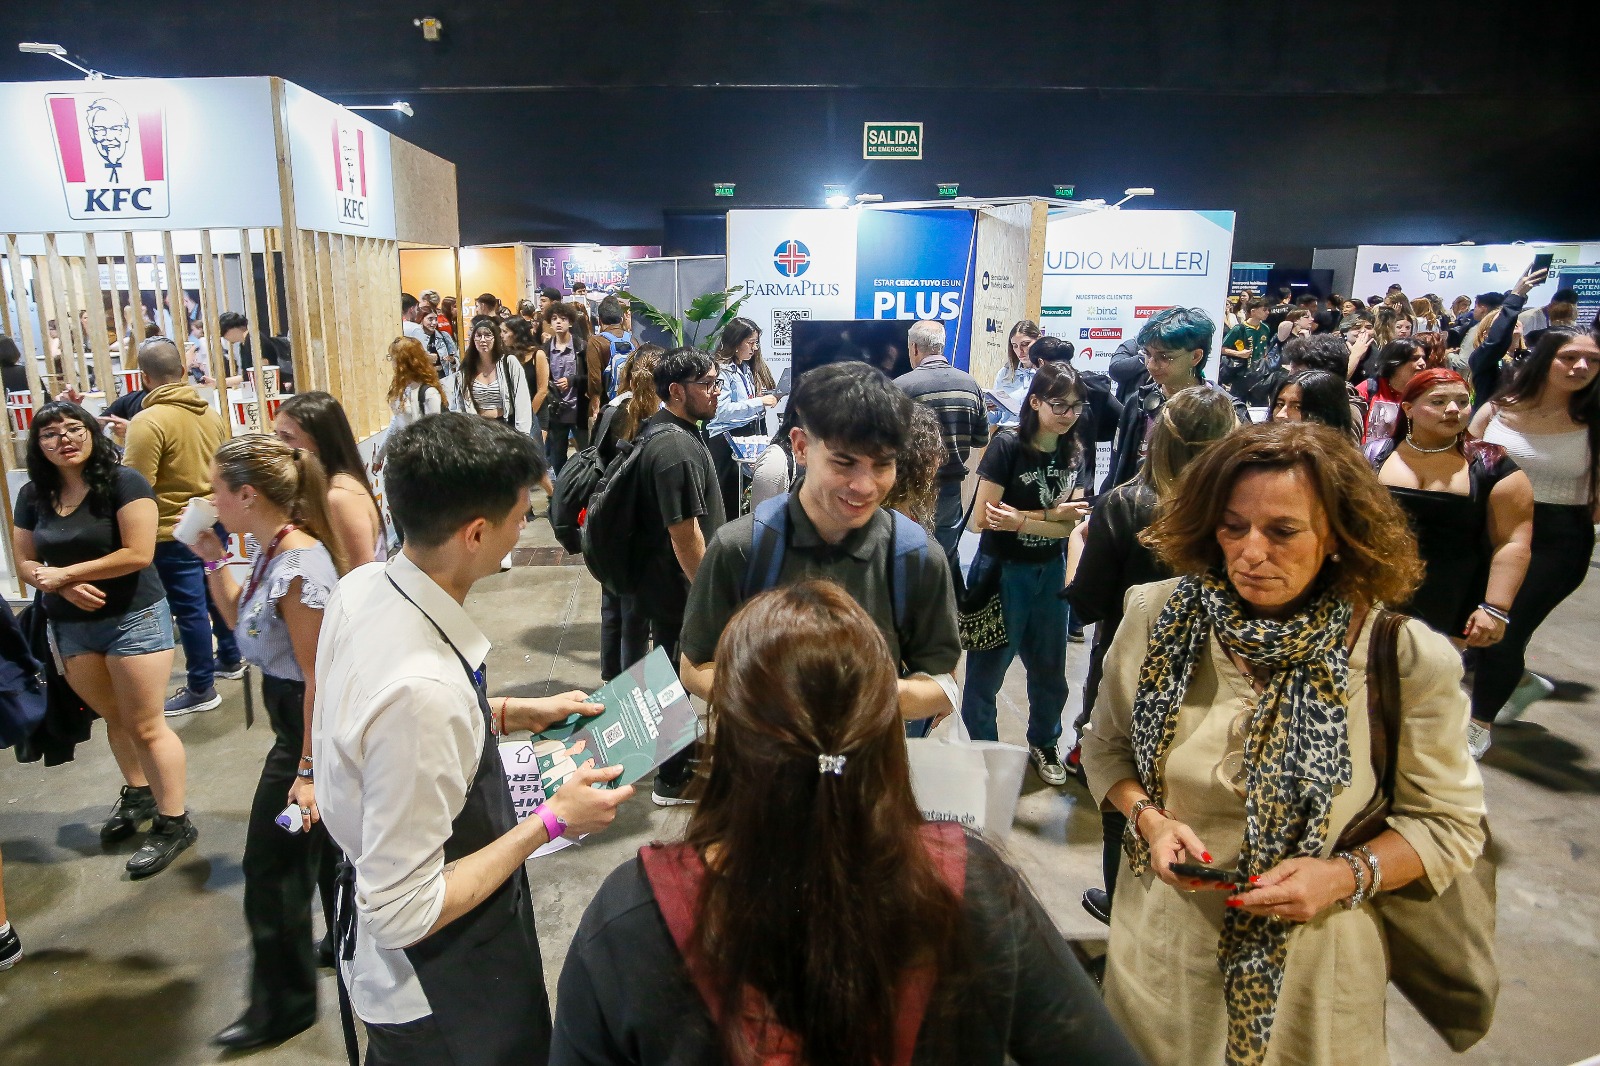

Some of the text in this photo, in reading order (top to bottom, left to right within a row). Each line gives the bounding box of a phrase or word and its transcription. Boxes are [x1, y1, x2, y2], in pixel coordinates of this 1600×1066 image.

[868, 129, 918, 145] SALIDA
[84, 187, 153, 212] KFC
[343, 197, 365, 220] KFC
[1046, 247, 1203, 270] UDIO MÜLLER
[873, 278, 961, 287] ESTAR CERCA TUYO ES UN
[1439, 271, 1454, 279] BA
[873, 291, 960, 321] PLUS
[1096, 306, 1118, 316] bind
[631, 686, 660, 740] STARBUCKS
